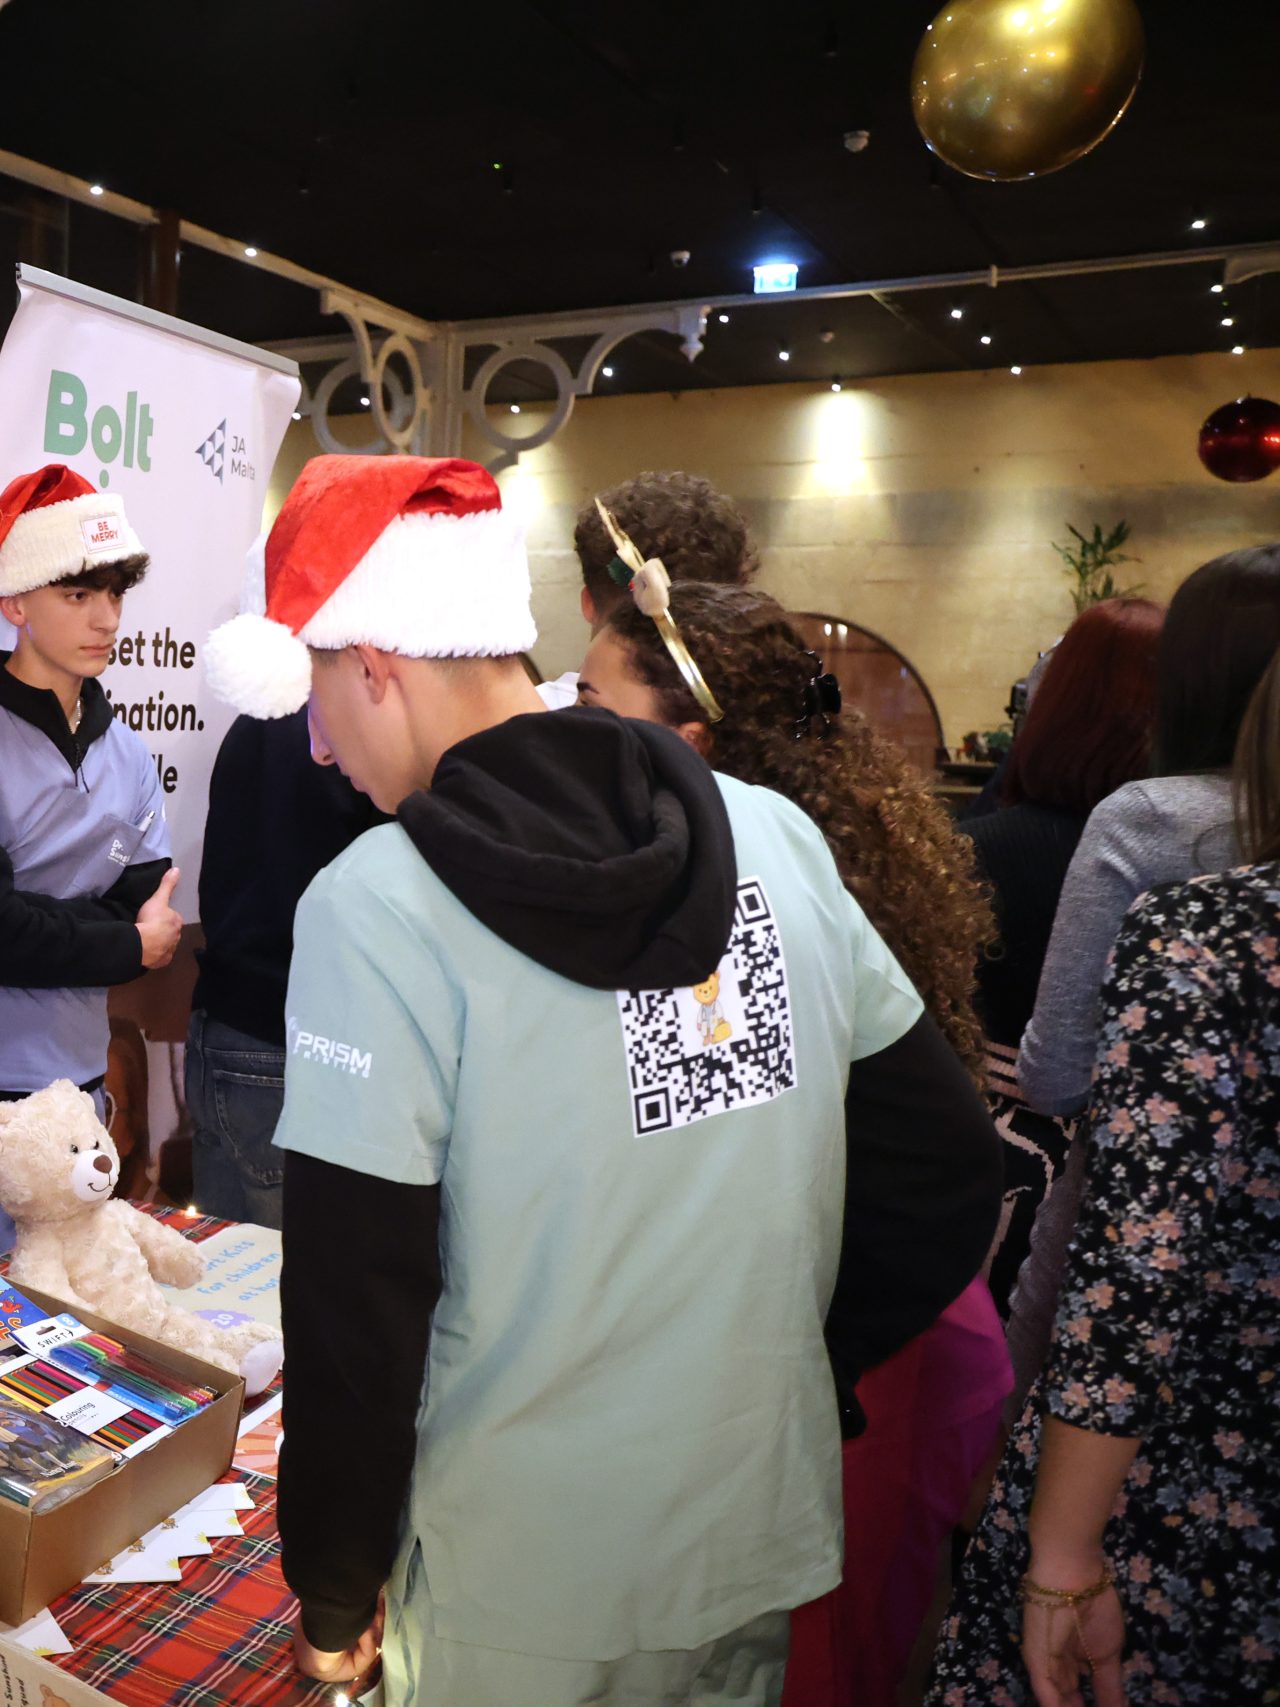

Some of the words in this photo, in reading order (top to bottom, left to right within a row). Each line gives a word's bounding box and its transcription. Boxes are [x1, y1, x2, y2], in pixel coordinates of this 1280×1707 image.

[44, 369, 154, 488] Bolt
[232, 436, 246, 453] JA
[231, 459, 255, 480] Malta
[91, 530, 119, 544] MERRY
[97, 521, 109, 532] BE
[152, 627, 196, 669] the
[106, 689, 205, 731] nation.
[293, 1031, 372, 1073] PRISM
[211, 1313, 234, 1326] 20
[37, 1332, 68, 1348] SWIFT
[60, 1402, 96, 1421] Colouring
[0, 1653, 13, 1701] Sunshine
[16, 1677, 29, 1707] quad
